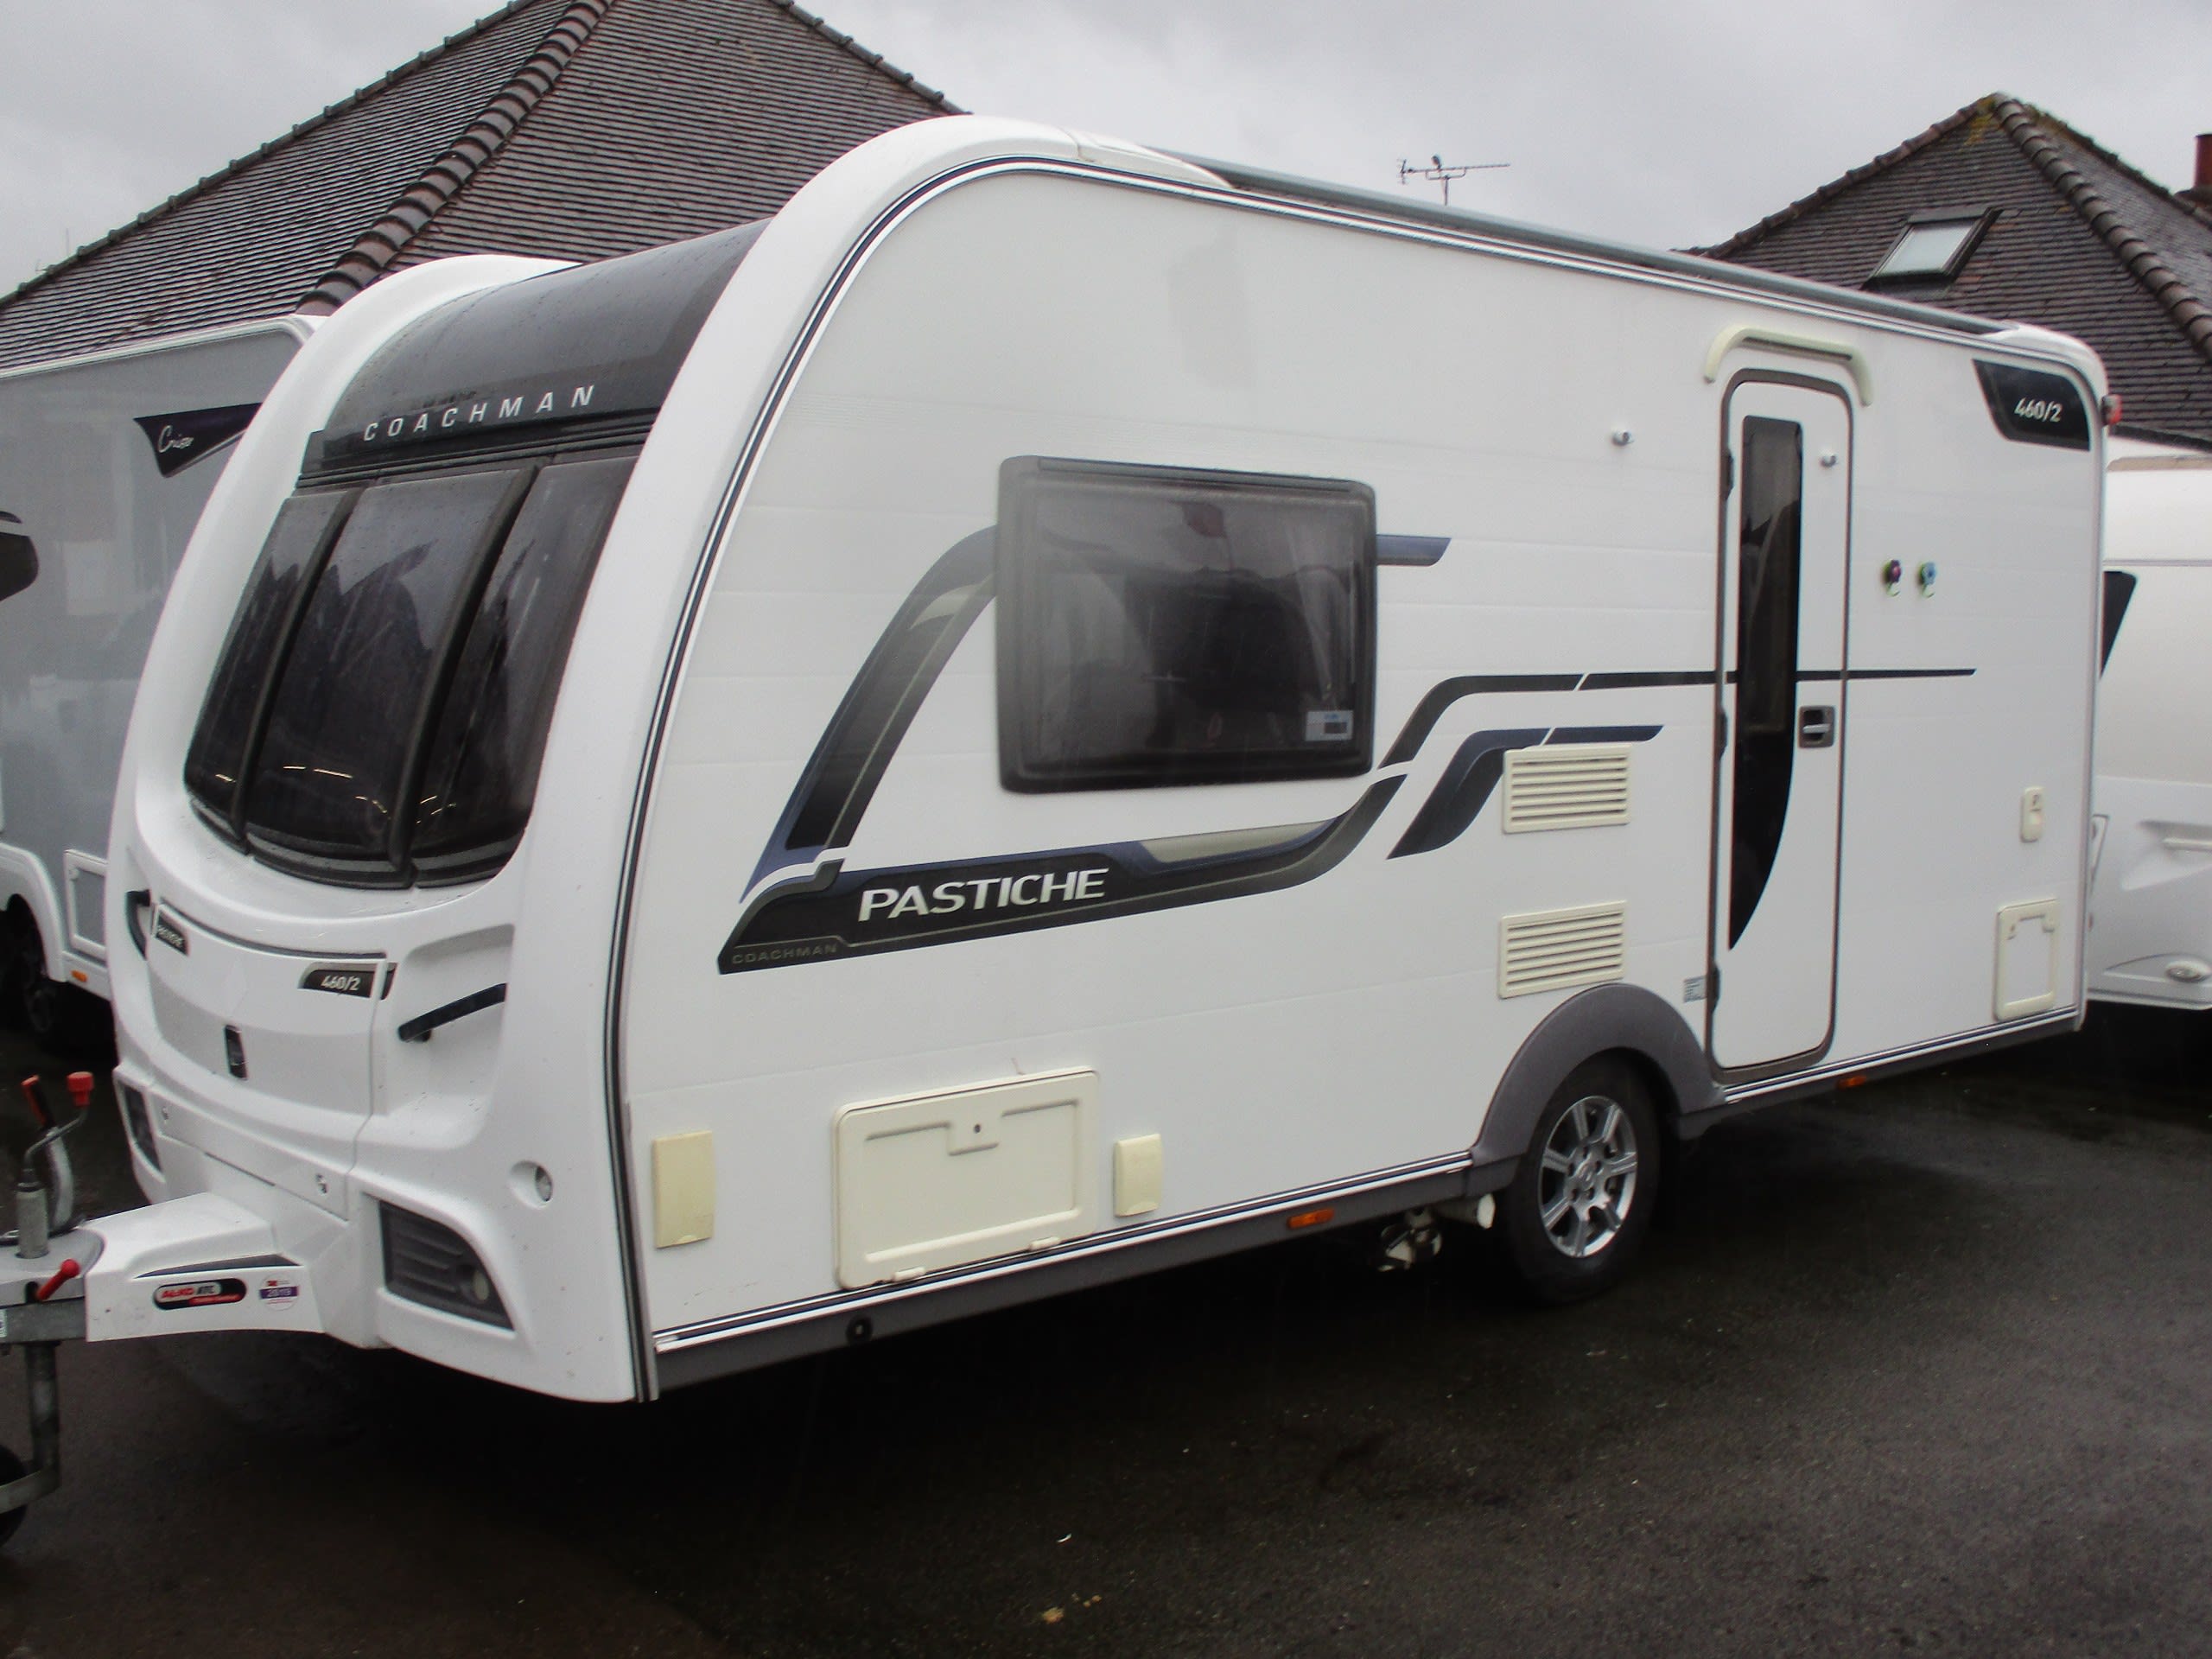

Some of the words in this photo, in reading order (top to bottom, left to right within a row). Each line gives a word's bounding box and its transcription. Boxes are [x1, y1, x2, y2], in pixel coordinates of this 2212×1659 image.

[363, 385, 594, 442] COACHMAN
[2014, 397, 2063, 423] 460/2
[858, 868, 1109, 922] PASTICHE
[732, 943, 837, 964] COACHMAN
[321, 975, 361, 991] 460/2
